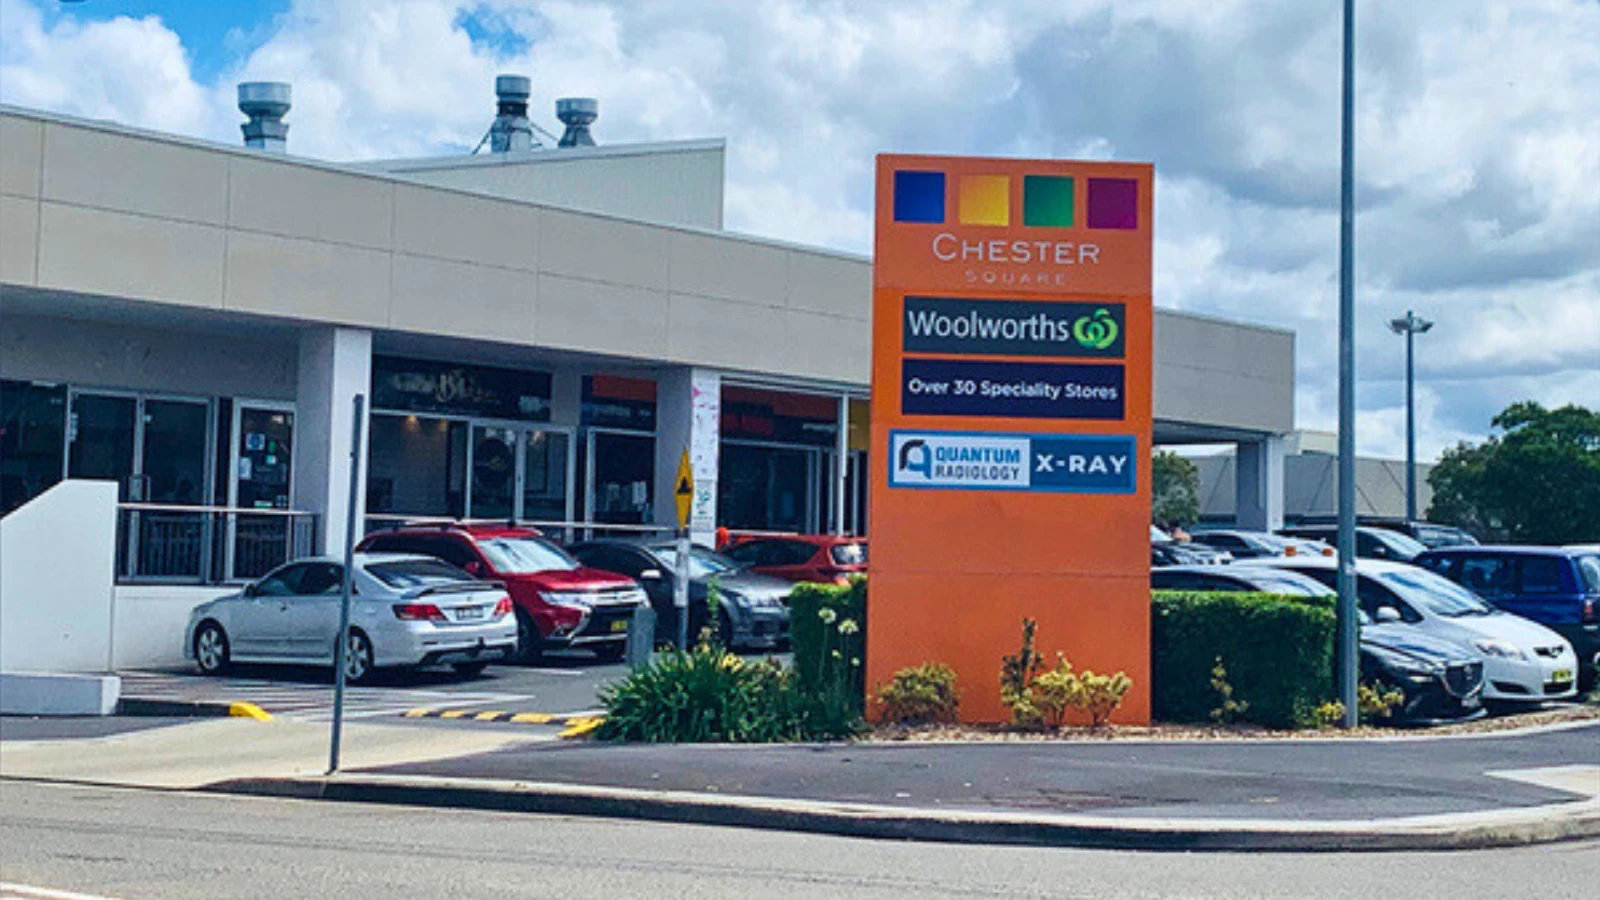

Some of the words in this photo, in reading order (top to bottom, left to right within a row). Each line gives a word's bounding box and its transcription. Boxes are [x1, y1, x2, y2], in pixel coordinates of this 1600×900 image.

[933, 233, 1100, 264] CHESTER
[965, 269, 1066, 285] SQUARE
[908, 311, 1069, 341] Woolworths
[908, 378, 949, 395] Over
[954, 380, 976, 395] 30
[980, 380, 1060, 400] Speciality
[1065, 383, 1117, 400] Stores
[935, 446, 1020, 463] QUANTUM
[1035, 454, 1127, 474] X-RAY
[935, 465, 1020, 480] RADIOLOGY
